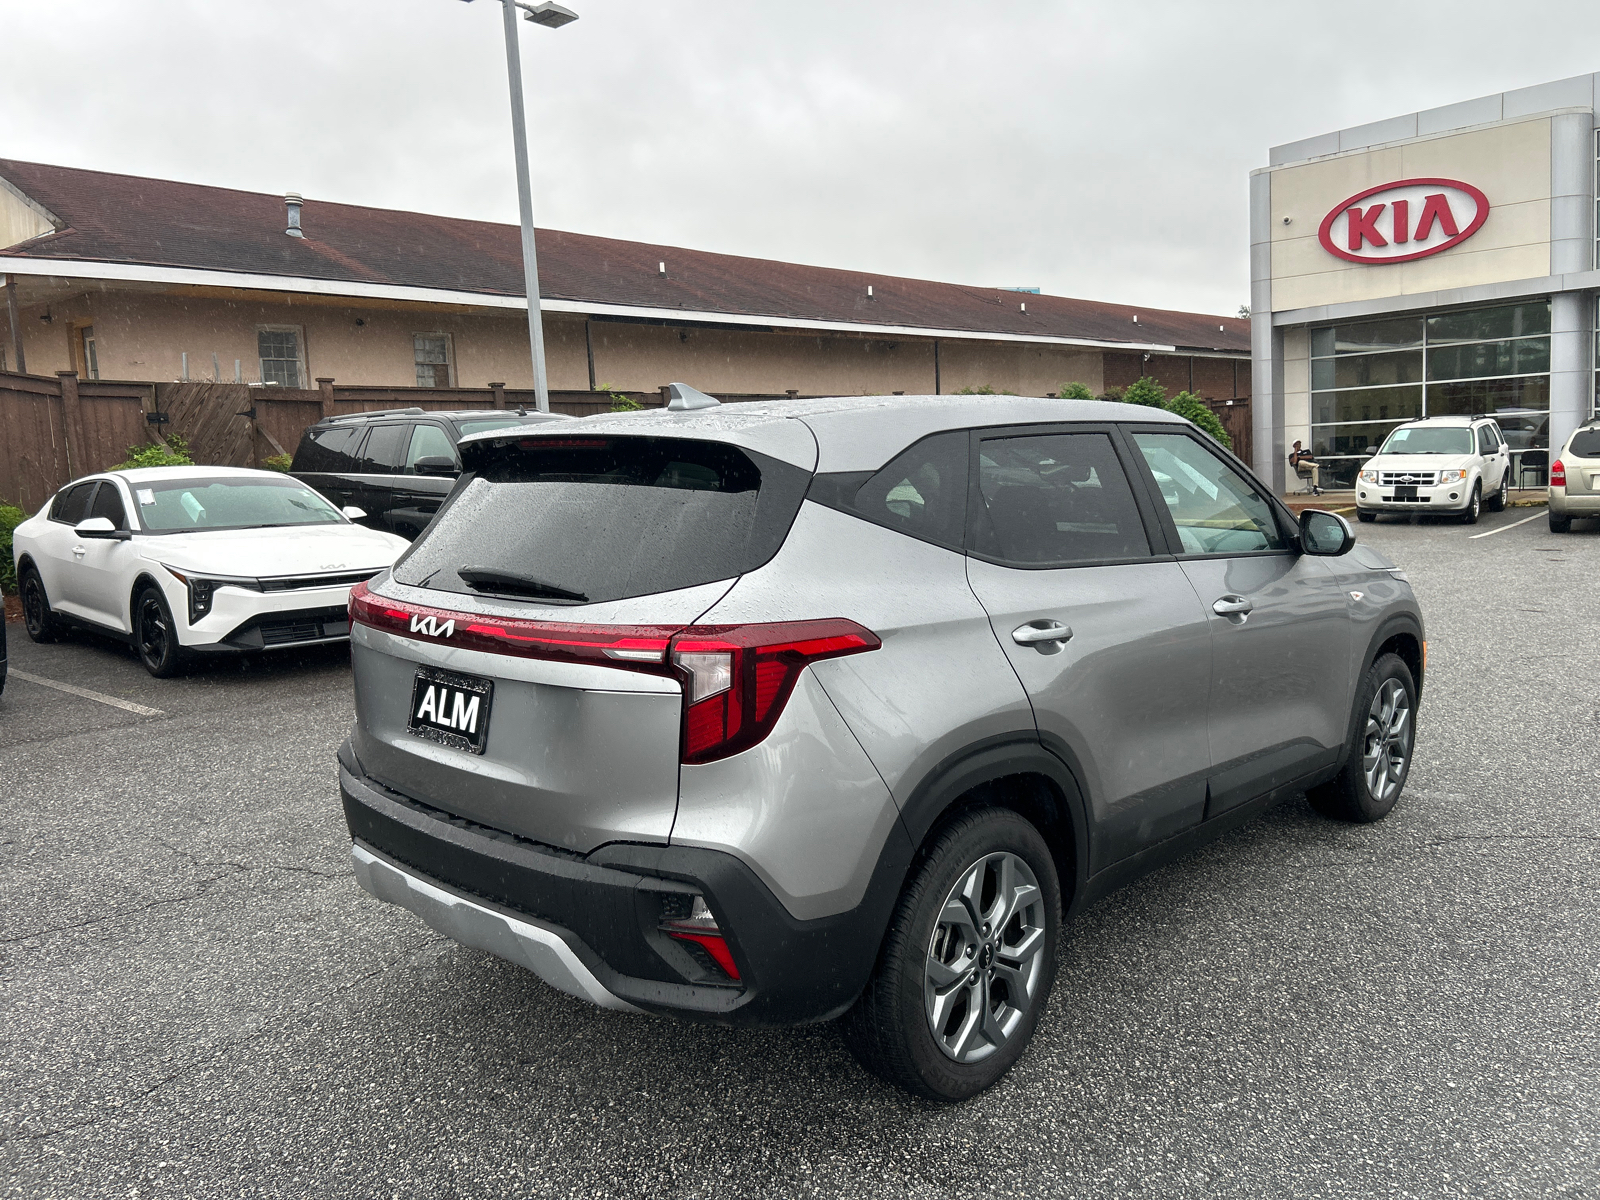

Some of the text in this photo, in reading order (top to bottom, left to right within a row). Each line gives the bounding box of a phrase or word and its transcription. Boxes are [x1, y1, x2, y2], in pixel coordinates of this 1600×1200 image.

[1346, 193, 1460, 251] KIA
[410, 613, 456, 638] KIA
[416, 685, 480, 734] ALM
